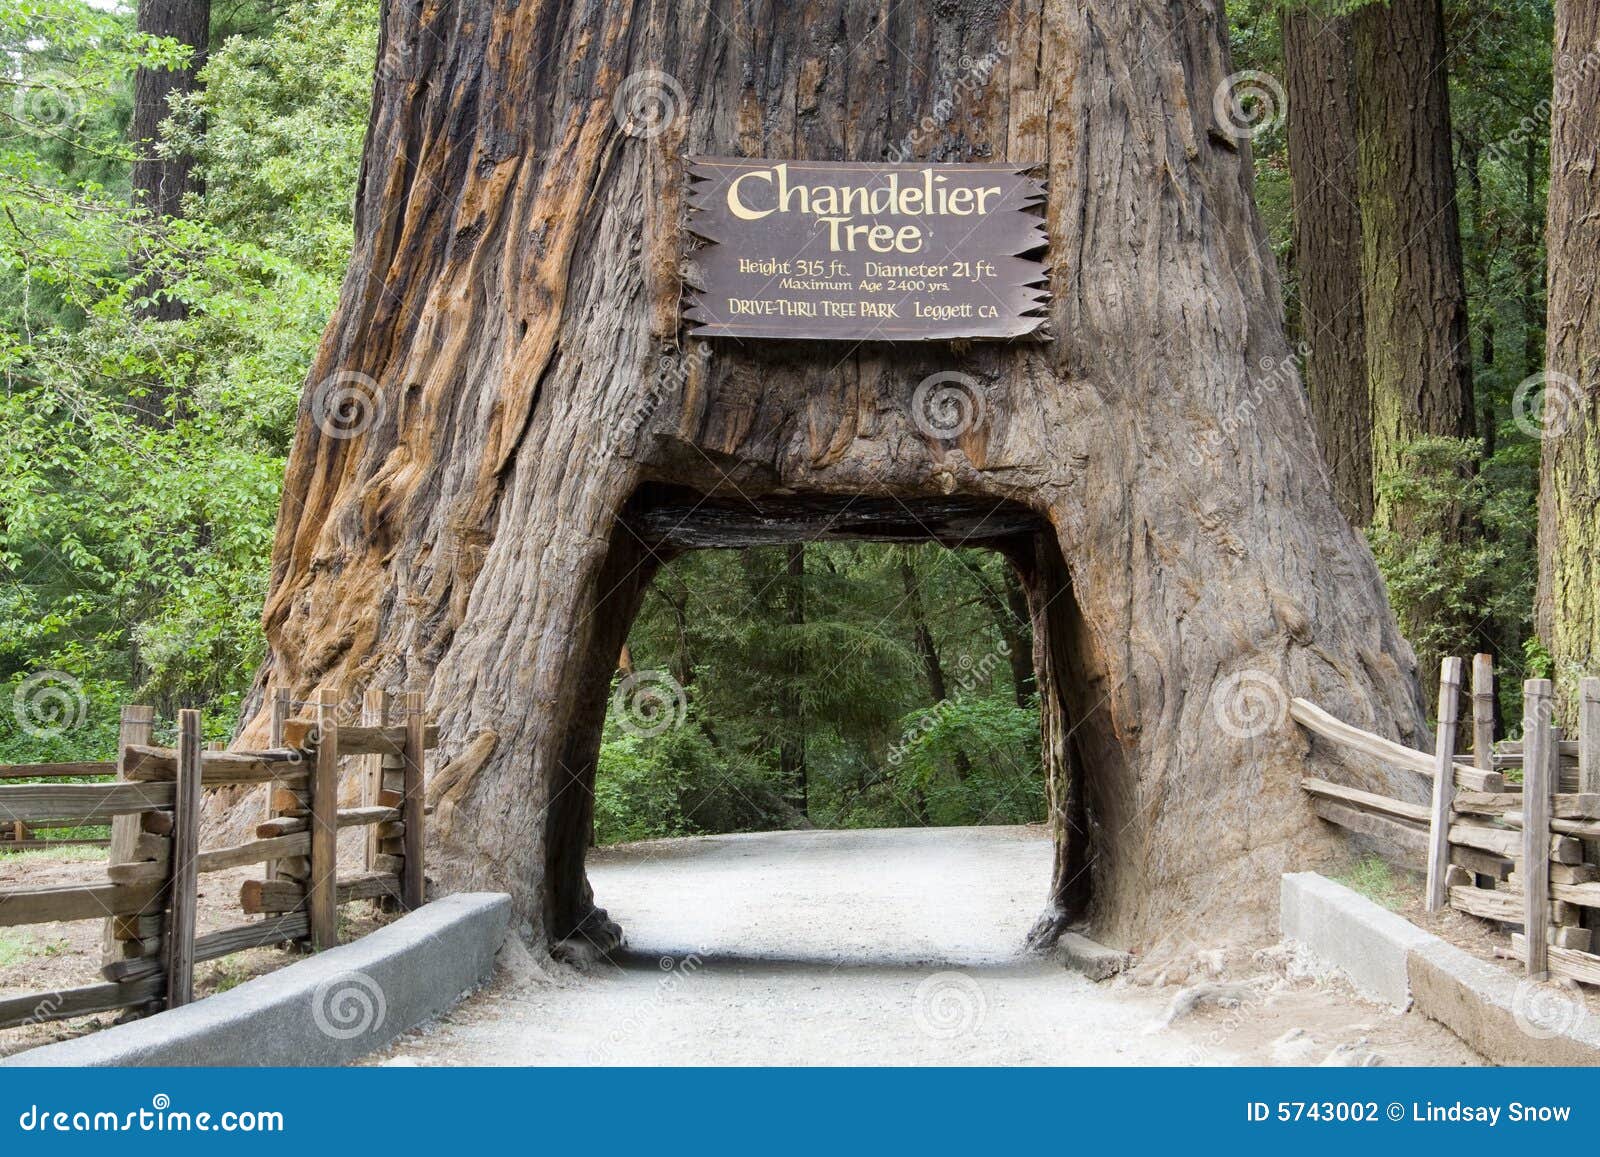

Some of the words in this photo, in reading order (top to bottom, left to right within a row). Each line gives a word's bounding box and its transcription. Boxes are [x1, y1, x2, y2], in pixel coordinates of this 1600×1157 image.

[727, 163, 1001, 220] Chandelier
[814, 216, 922, 254] Tree
[738, 257, 792, 276] Height
[795, 260, 825, 276] 315
[824, 259, 852, 279] ft.
[864, 261, 949, 278] Diameter
[951, 261, 971, 277] 21
[971, 260, 998, 283] ft.
[778, 277, 853, 291] Maximum
[858, 279, 883, 293] Age
[887, 279, 926, 292] 2400
[927, 281, 950, 293] yrs.
[728, 297, 818, 318] DRIVE-THRU
[820, 300, 857, 318] TREE
[859, 300, 900, 319] PARK
[913, 301, 973, 320] Leggett
[978, 305, 999, 318] CA
